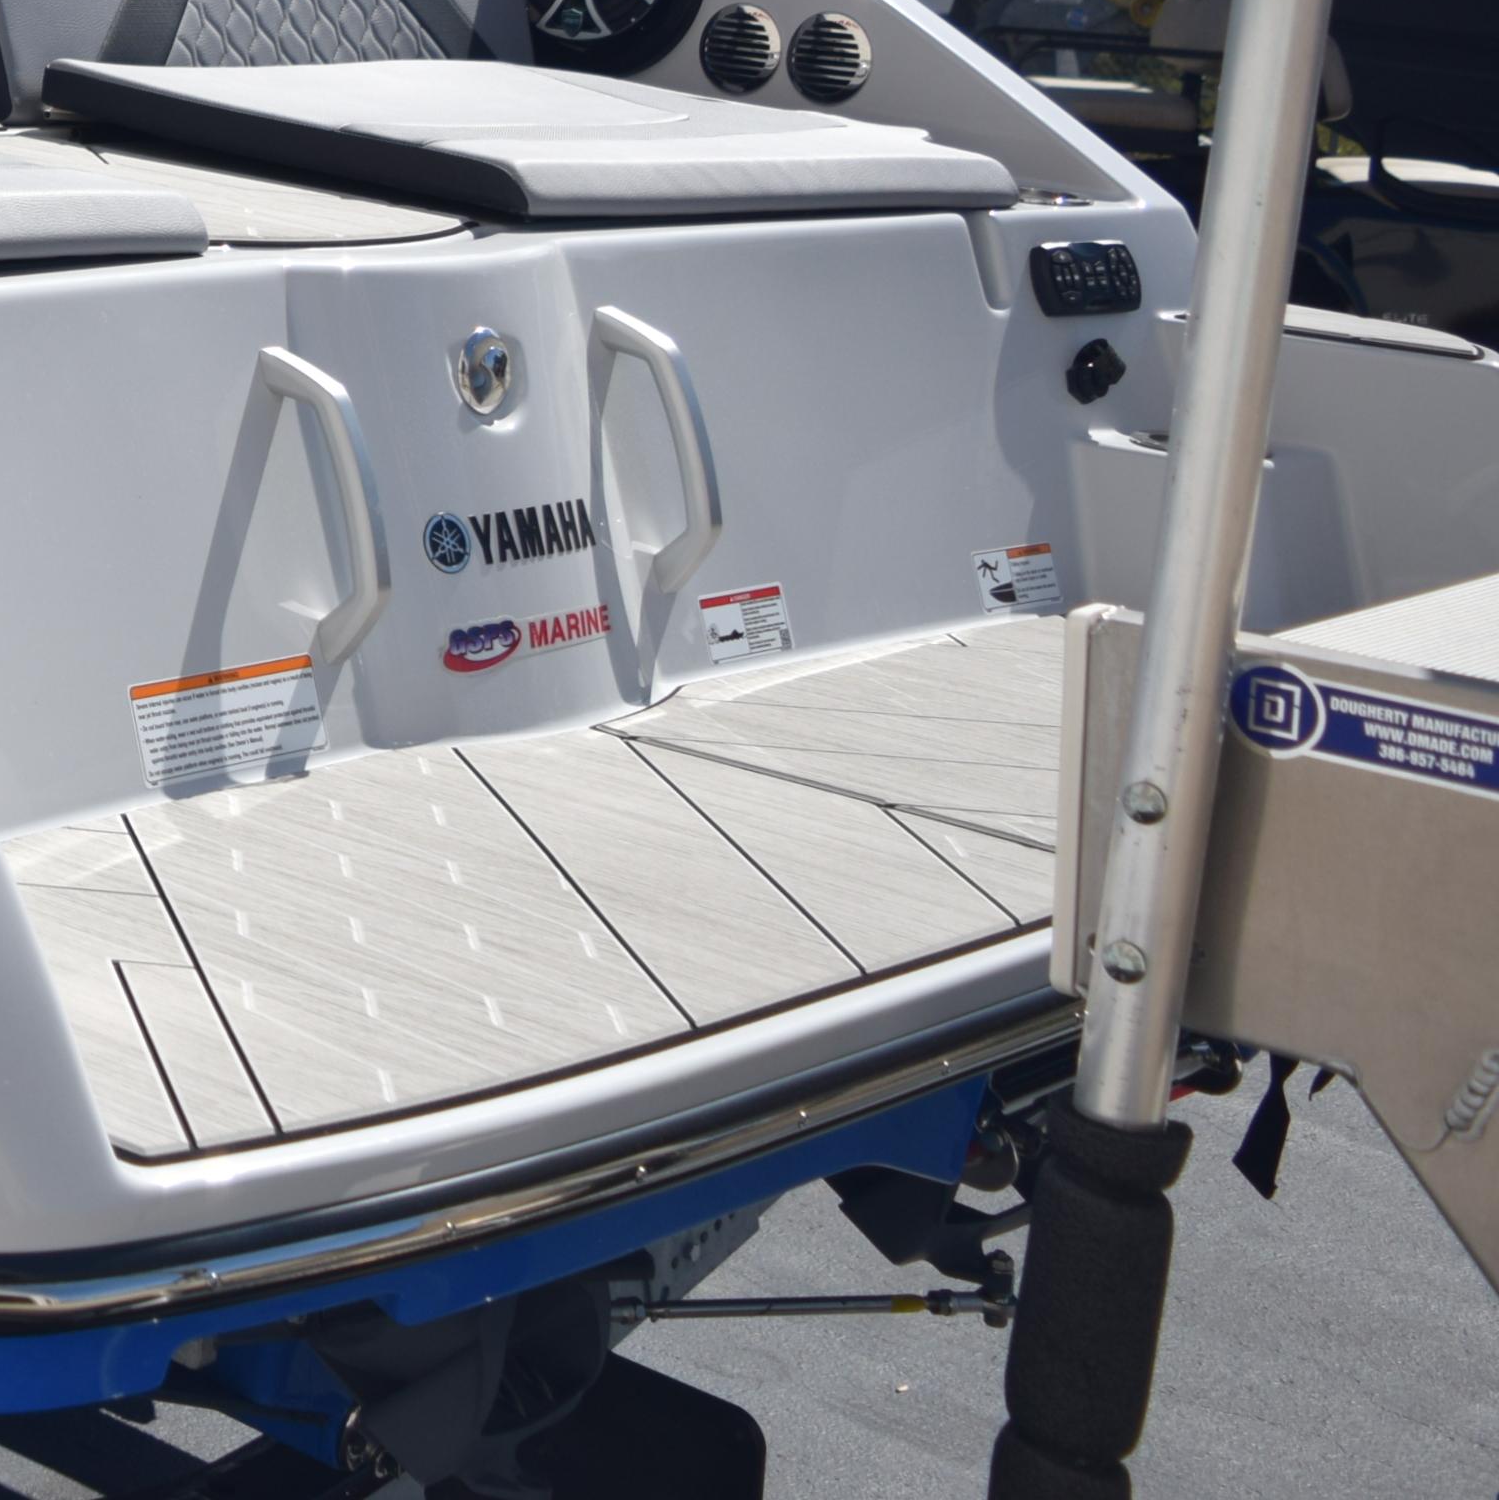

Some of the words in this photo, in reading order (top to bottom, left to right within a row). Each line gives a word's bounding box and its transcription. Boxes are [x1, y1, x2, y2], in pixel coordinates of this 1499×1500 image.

[468, 498, 596, 565] YAMAHA
[529, 604, 611, 649] MARINE
[1330, 696, 1408, 726] DOUGHERTY
[1412, 713, 1499, 747] MANUFACTU
[1364, 722, 1493, 764] WWW.DMADE.COM
